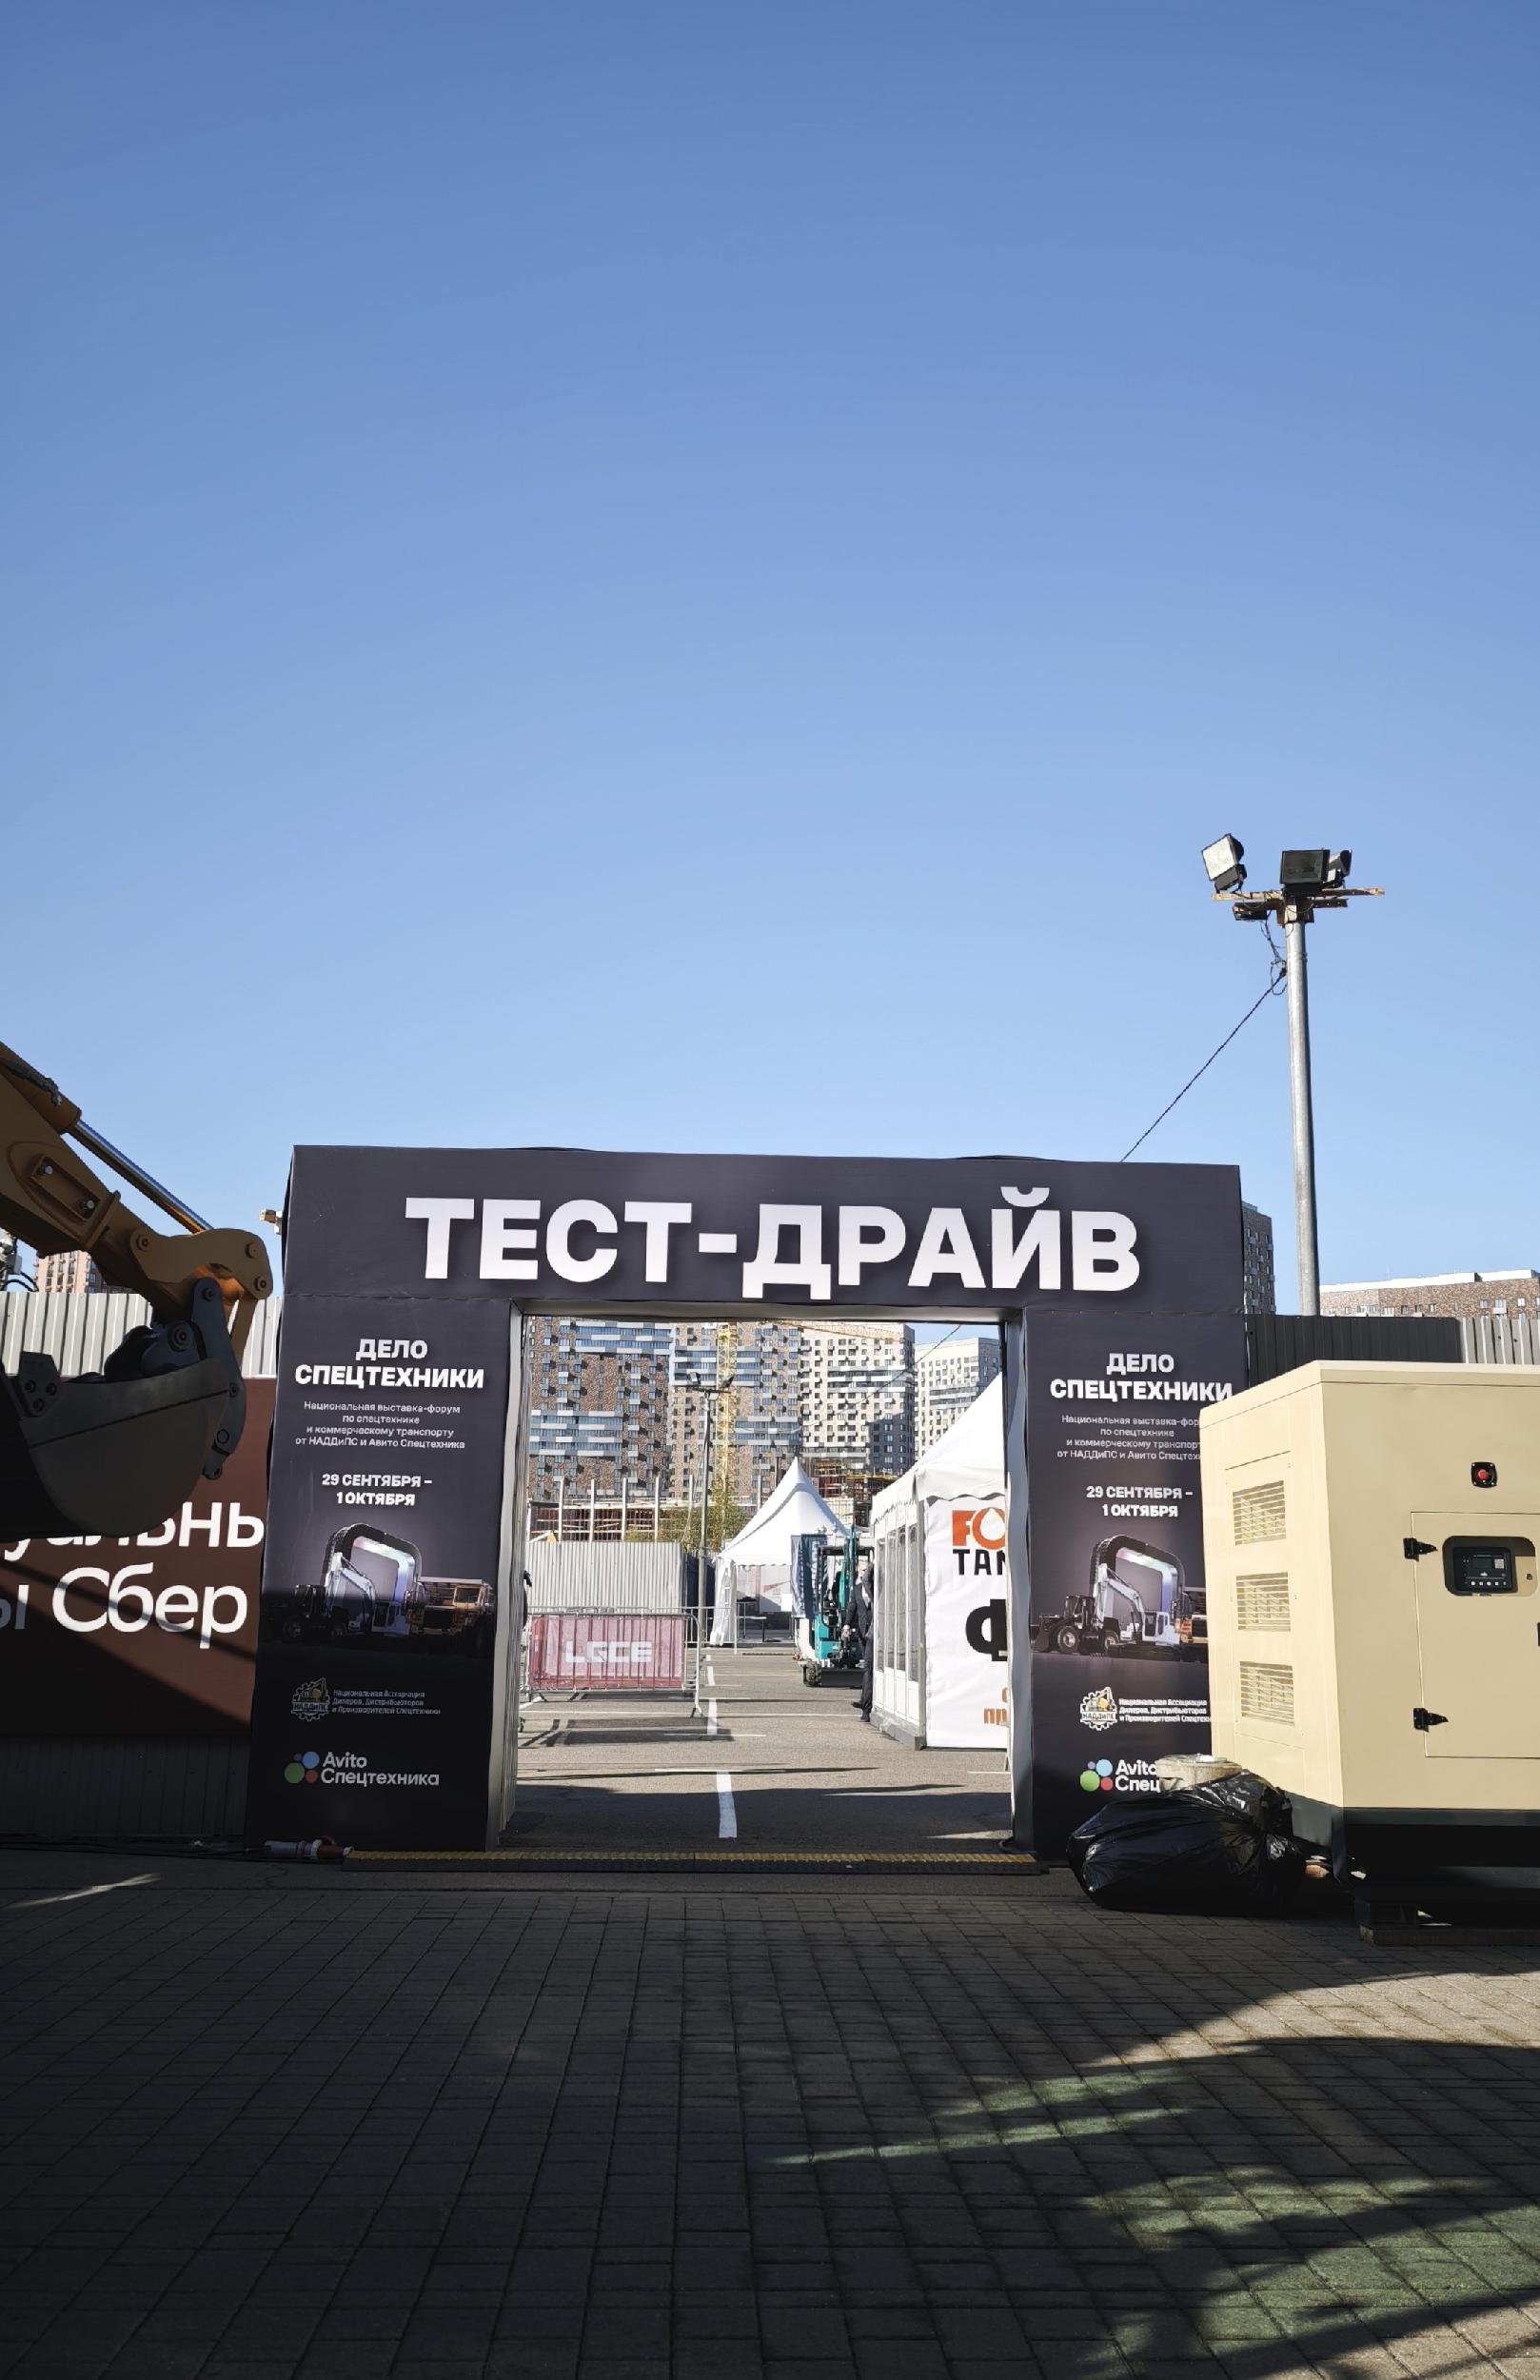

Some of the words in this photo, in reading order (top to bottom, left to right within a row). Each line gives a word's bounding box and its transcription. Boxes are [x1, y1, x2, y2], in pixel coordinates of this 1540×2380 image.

[404, 1186, 1140, 1300] ТЕСТ-ДРАЙВ
[355, 1339, 427, 1360] ДЕЛО
[1106, 1353, 1175, 1375] ДЕЛО
[295, 1364, 484, 1389] СПЕЦТЕХНИКИ
[1050, 1378, 1233, 1402] СПЕЦТЕХНИКИ
[304, 1401, 375, 1411] Национальная
[378, 1403, 461, 1414] выставка-форум
[343, 1415, 354, 1423] по
[356, 1416, 420, 1424] спецтехнике
[1061, 1415, 1131, 1425] Национальная
[315, 1426, 394, 1437] коммерческому
[397, 1429, 454, 1438] транспорту
[309, 1437, 358, 1446] НАДДиПС
[368, 1438, 398, 1447] Авито
[401, 1439, 465, 1449] Спецтехника
[1075, 1440, 1152, 1449] коммерческому
[1071, 1450, 1118, 1459] НАДДиПС
[1128, 1451, 1156, 1459] Авито
[322, 1474, 339, 1486] 29
[342, 1475, 421, 1487] СЕНТЯБРЯ
[1086, 1486, 1103, 1498] 29
[1106, 1486, 1182, 1499] СЕНТЯБРЯ
[52, 1562, 247, 1649] Сбер
[322, 1752, 367, 1769] Avito
[1116, 1759, 1157, 1775] Avito
[320, 1768, 440, 1787] Спецтехника
[1116, 1775, 1161, 1794] Спец
